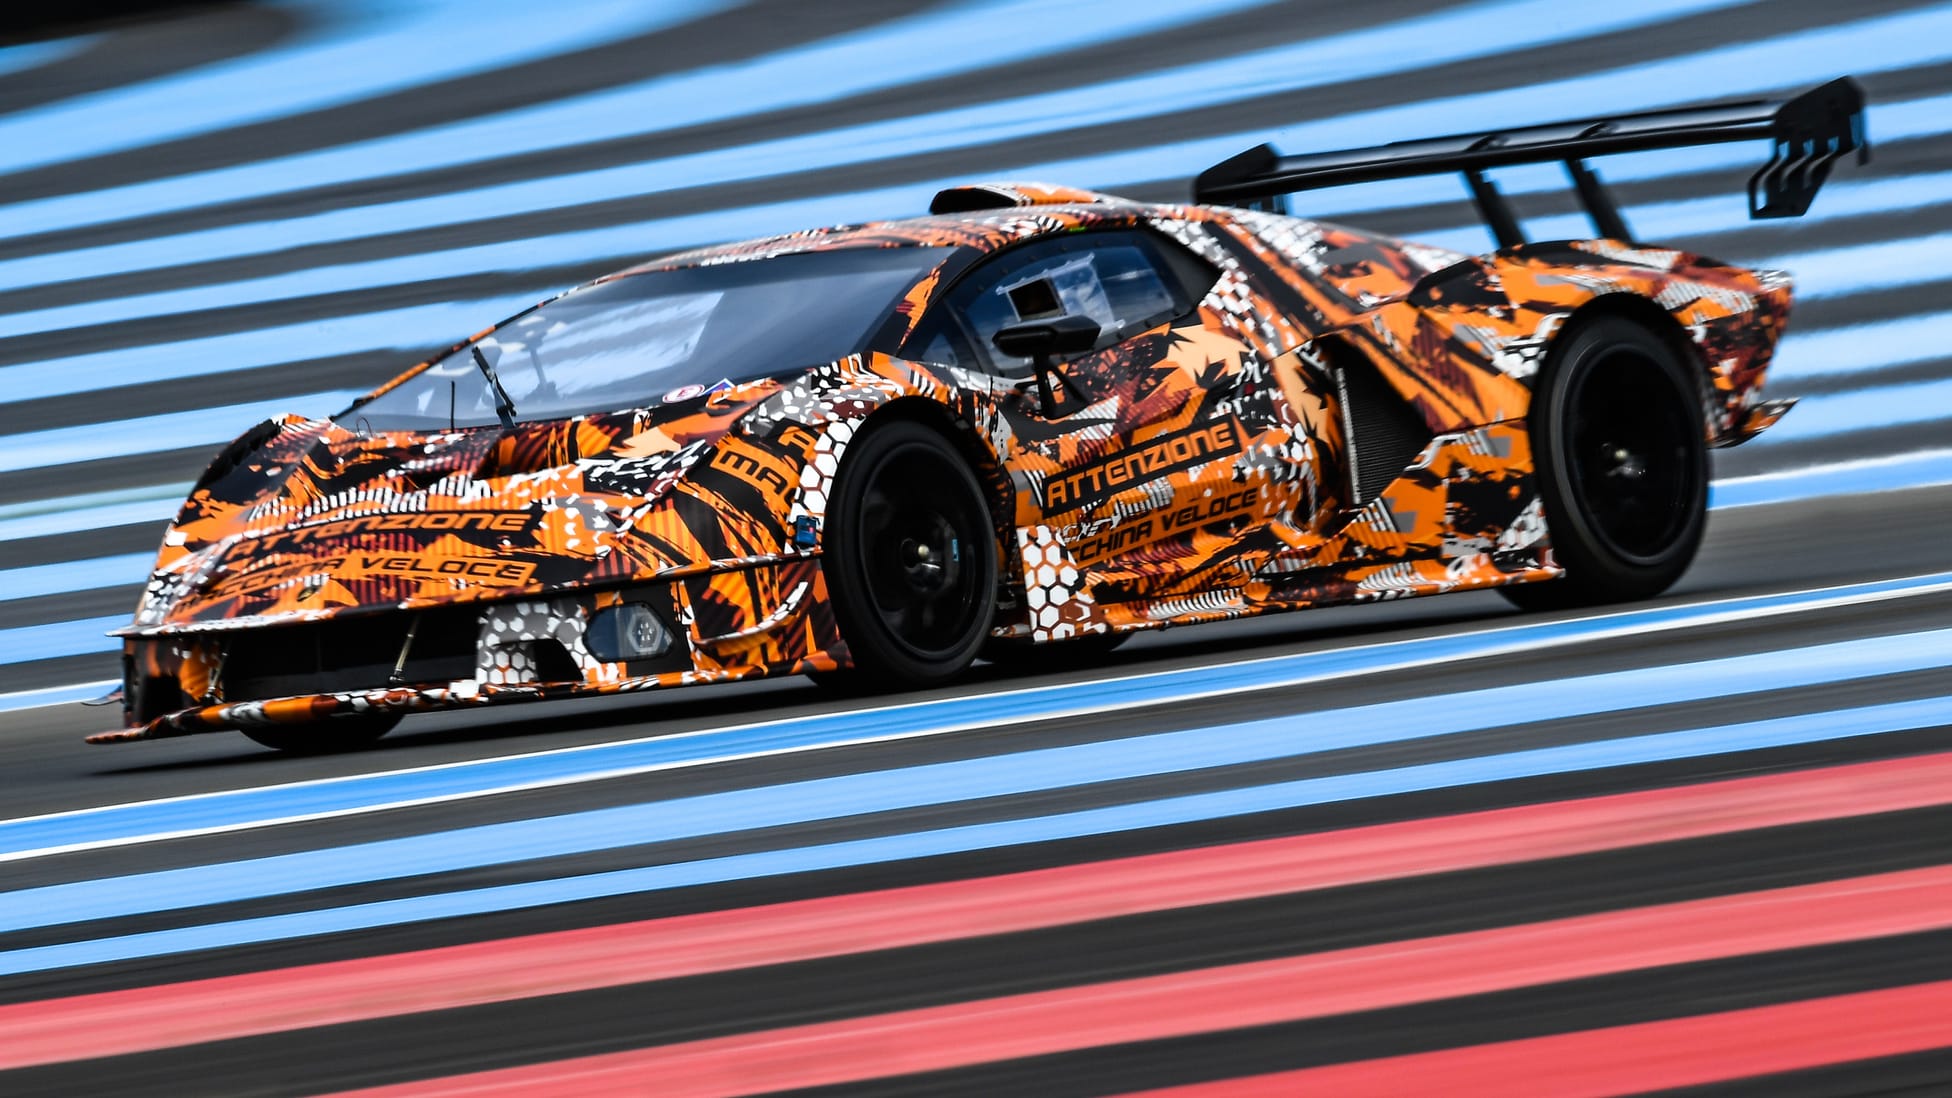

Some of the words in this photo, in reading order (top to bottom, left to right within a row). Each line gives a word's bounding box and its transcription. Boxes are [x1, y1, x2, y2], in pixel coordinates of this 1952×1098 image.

[1047, 422, 1235, 508] ATTENZIONE
[1161, 487, 1258, 531] VELOCE
[225, 512, 533, 561] ATTENZIONE
[361, 556, 529, 581] VELOCE
